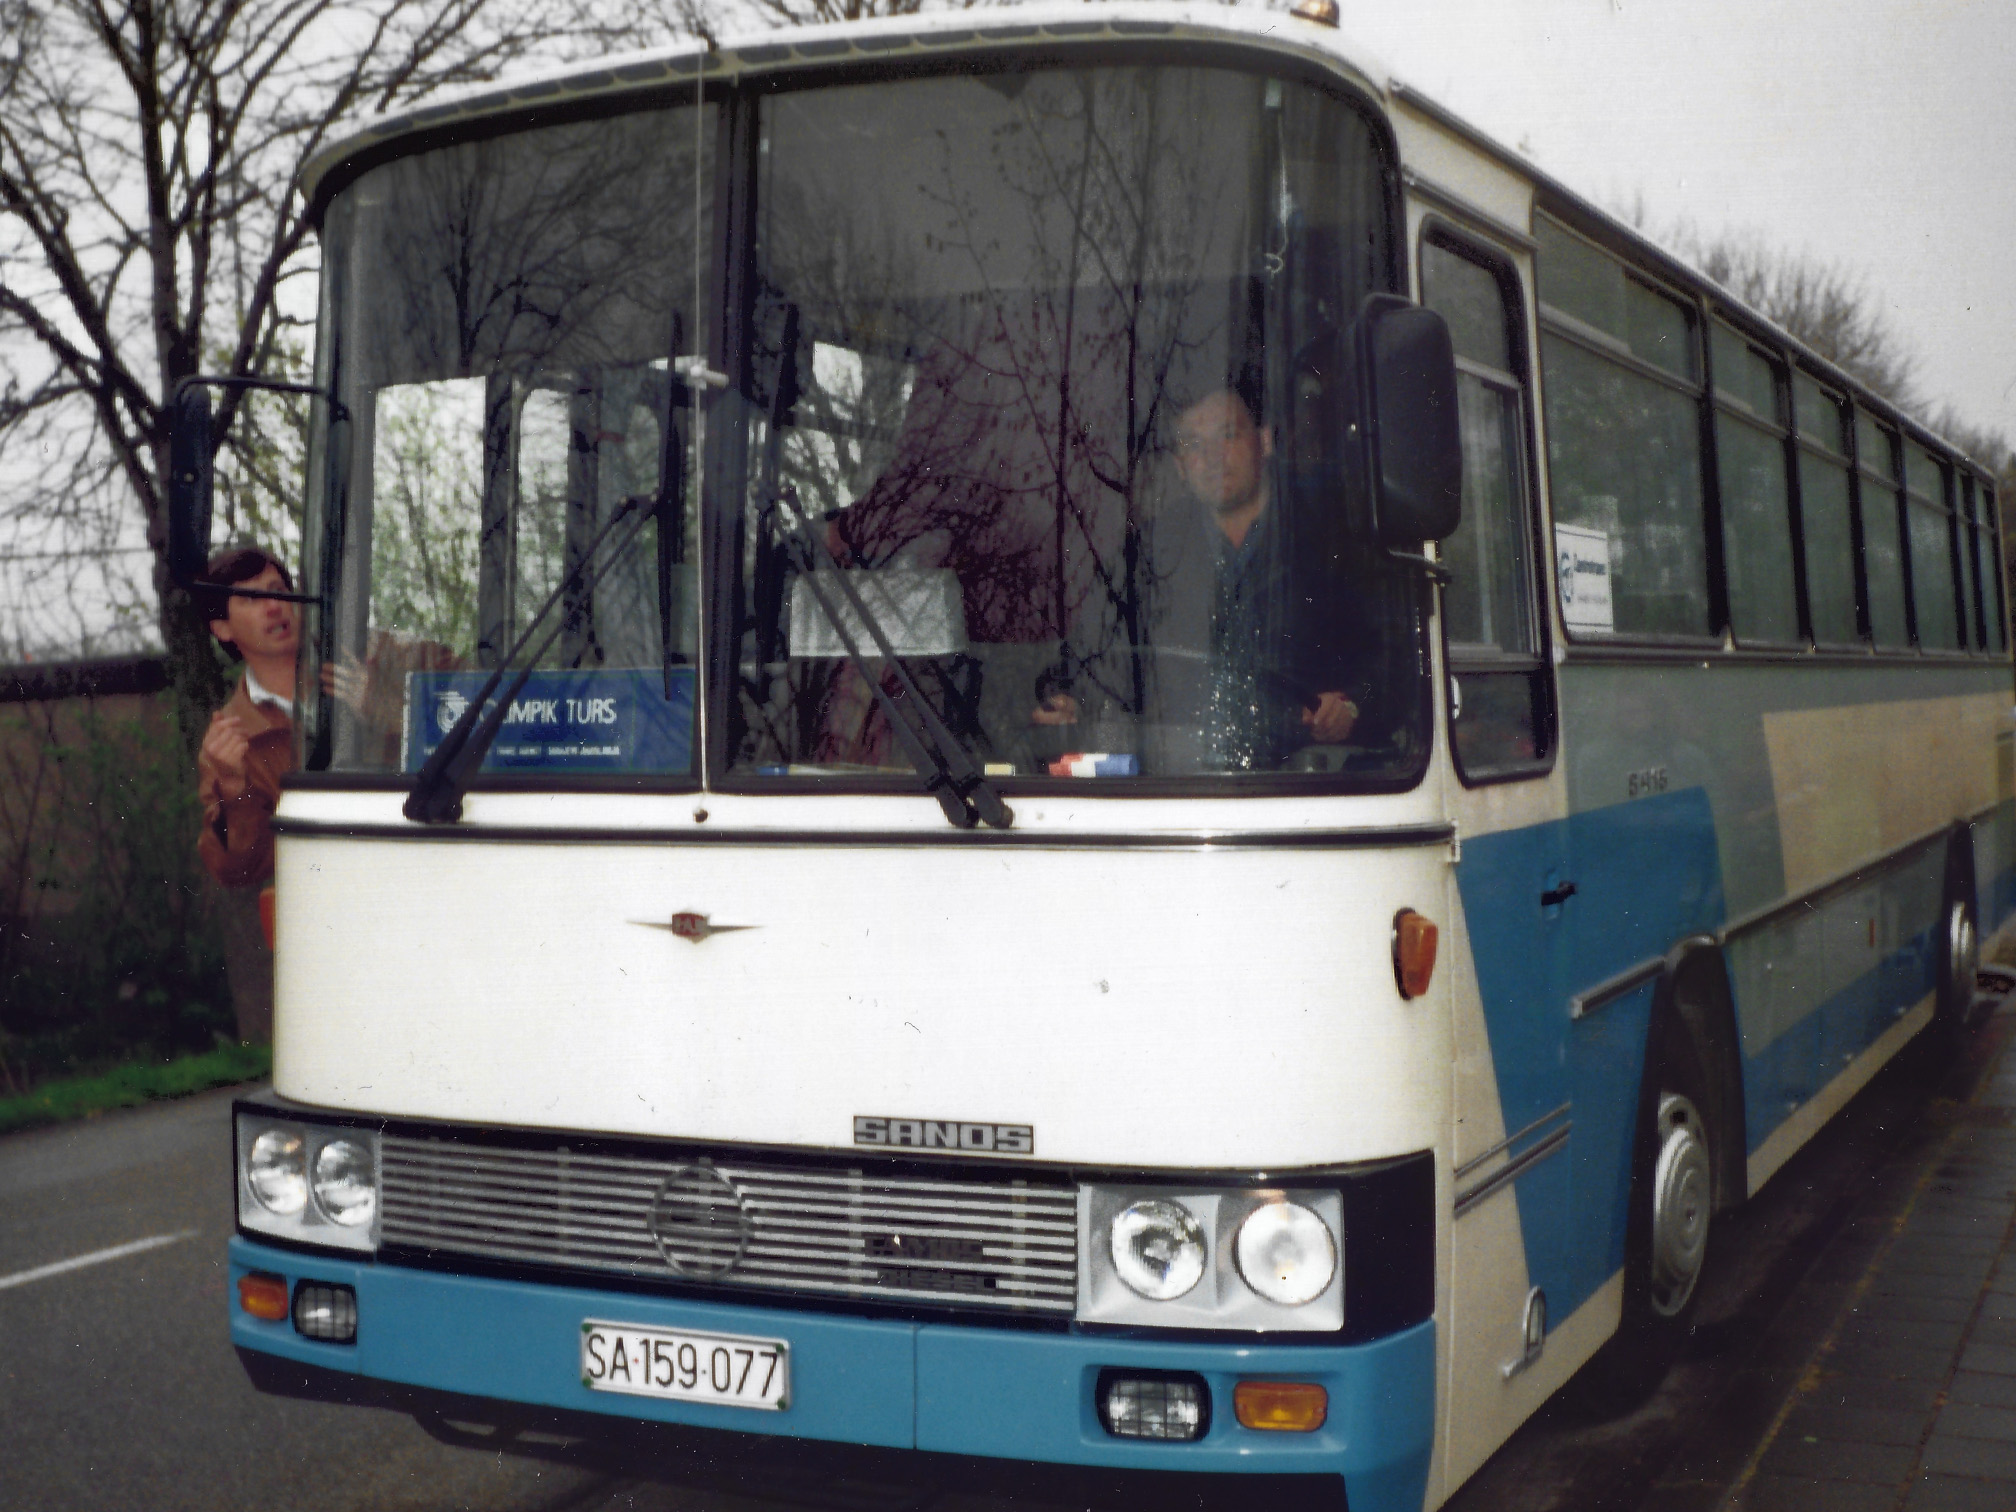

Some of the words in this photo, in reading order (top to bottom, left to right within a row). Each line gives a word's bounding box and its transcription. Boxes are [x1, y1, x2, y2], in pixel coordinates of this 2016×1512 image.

[479, 698, 558, 724] IMPIK
[566, 698, 617, 724] TURS
[853, 1116, 1034, 1154] SANOS
